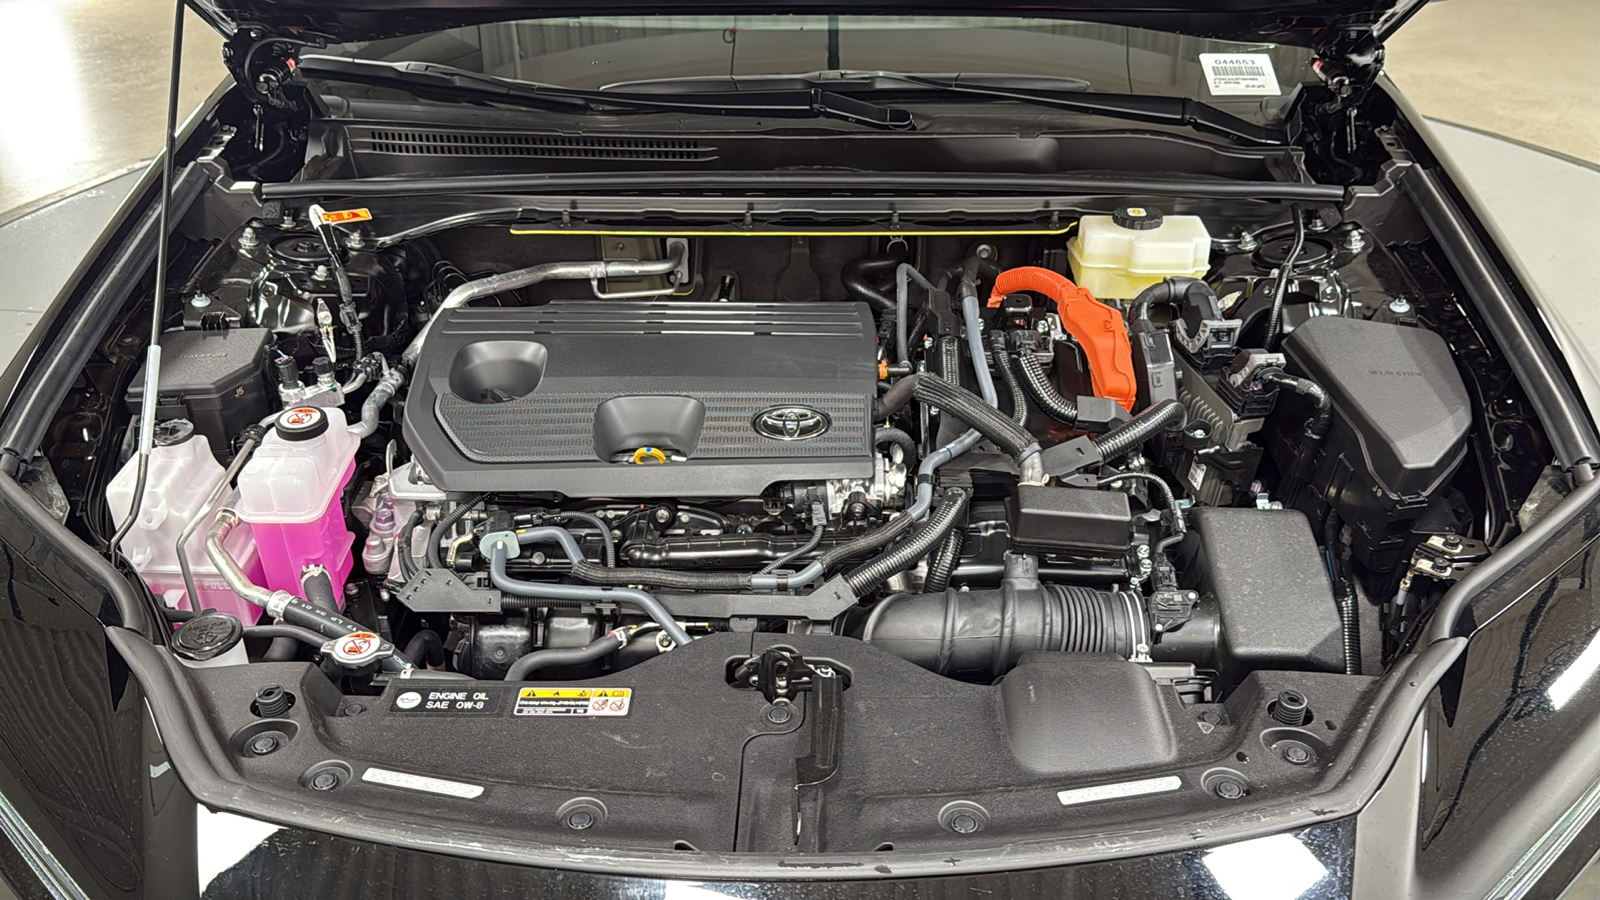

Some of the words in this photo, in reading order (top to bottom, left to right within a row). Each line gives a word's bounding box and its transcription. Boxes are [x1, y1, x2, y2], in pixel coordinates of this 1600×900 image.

[202, 581, 232, 590] FULL
[428, 692, 468, 700] ENGINE
[473, 692, 490, 700] OIL
[425, 701, 450, 709] SAE
